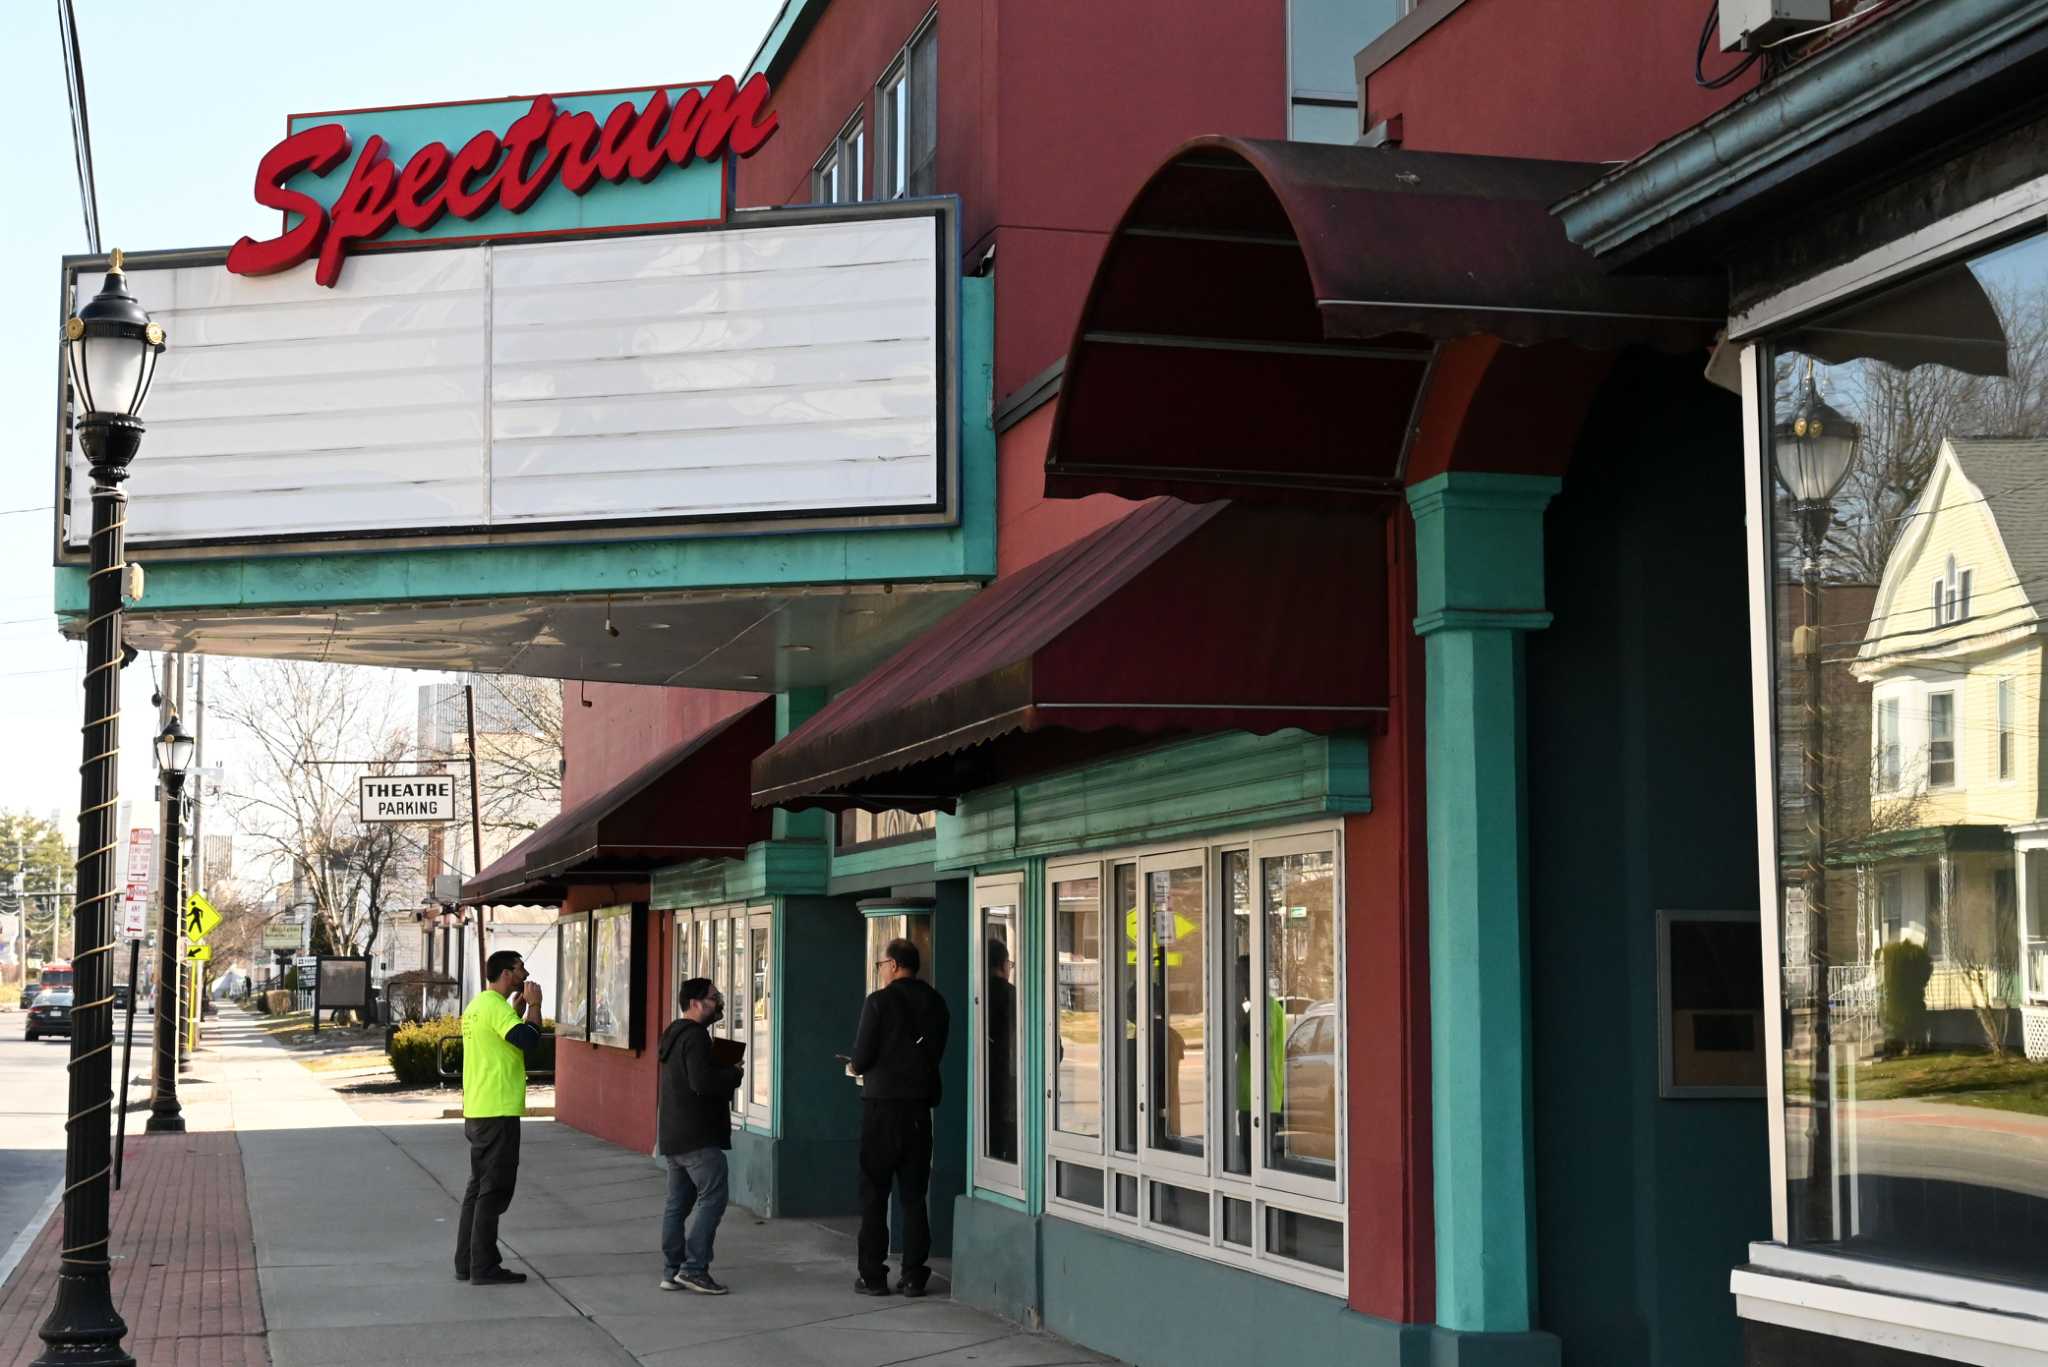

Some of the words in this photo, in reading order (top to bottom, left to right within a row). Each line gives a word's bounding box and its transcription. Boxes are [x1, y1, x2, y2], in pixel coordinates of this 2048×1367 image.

[226, 71, 779, 287] Spectrum
[365, 783, 449, 798] THEATRE
[378, 801, 438, 815] PARKING
